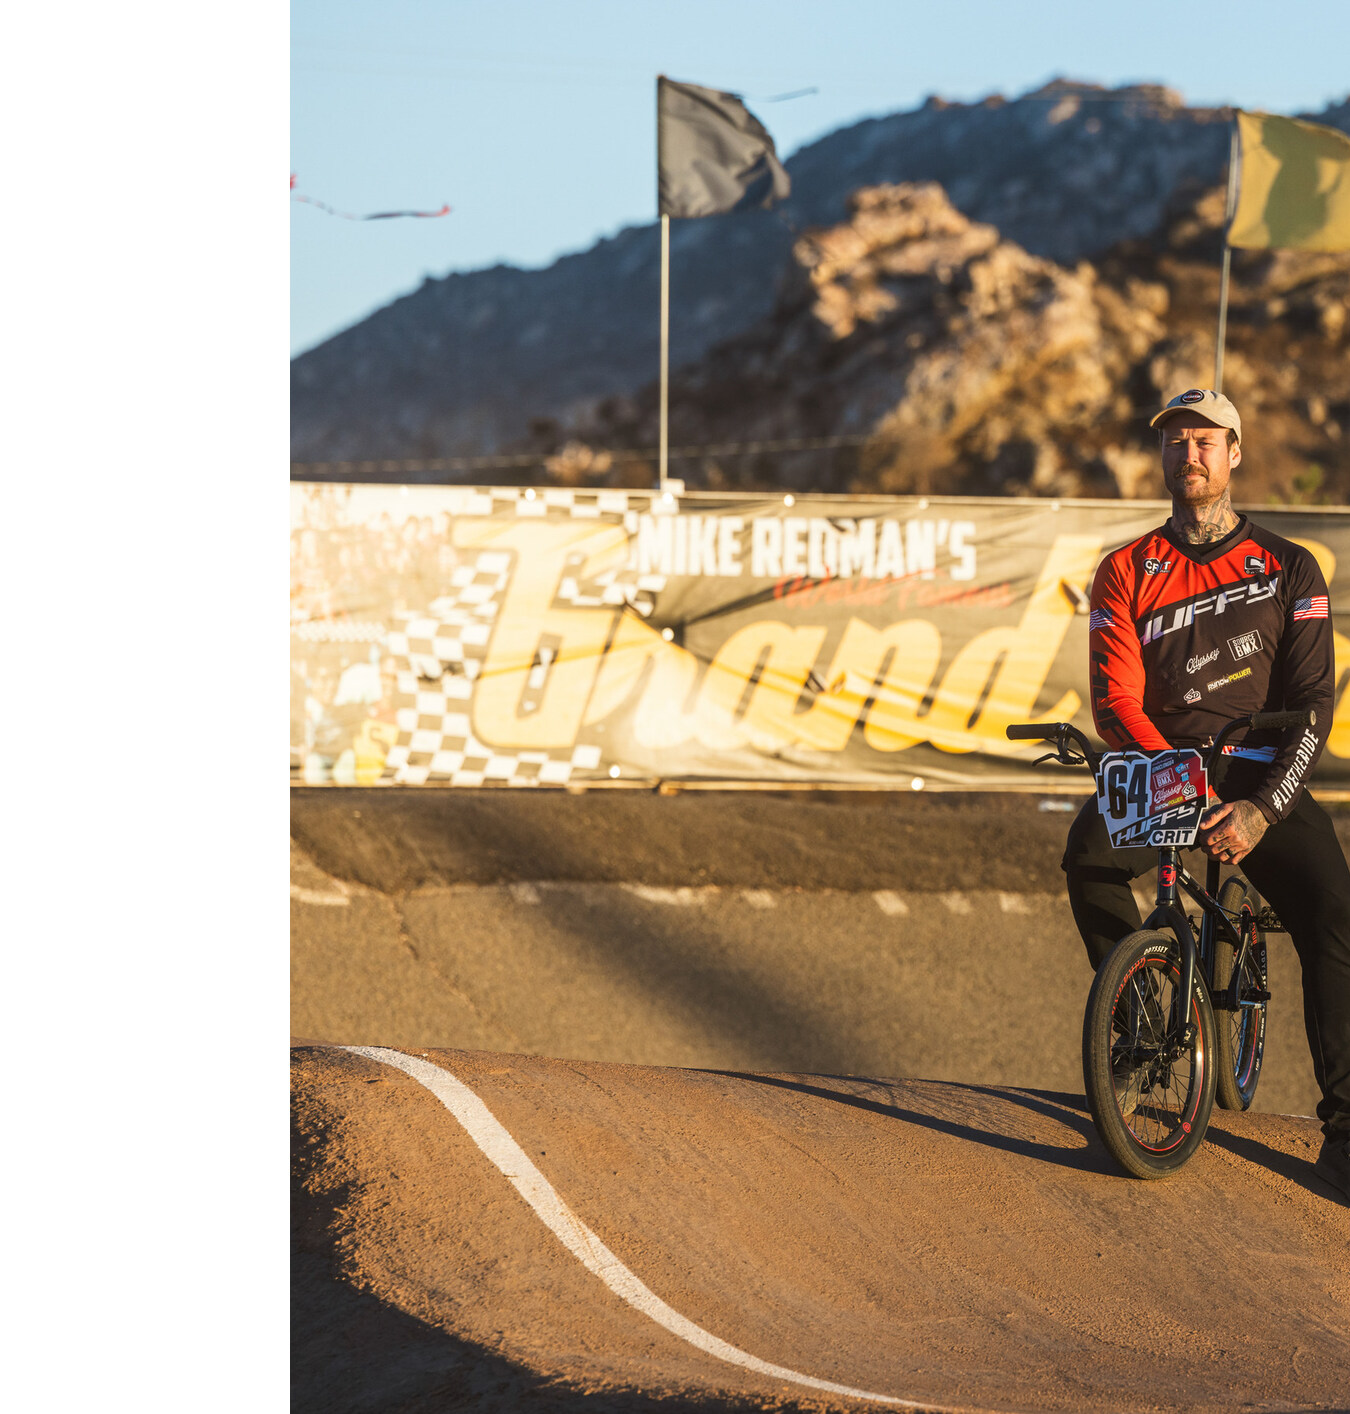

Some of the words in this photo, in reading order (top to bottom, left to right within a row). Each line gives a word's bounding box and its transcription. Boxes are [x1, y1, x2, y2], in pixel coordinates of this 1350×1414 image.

[639, 515, 744, 577] MIKE
[752, 517, 977, 581] REDMAN'S
[1232, 633, 1255, 647] SOURCE
[1235, 639, 1259, 658] BMX
[1186, 647, 1220, 675] Odyssey
[1271, 728, 1319, 812] #LIVETHERIDE
[1108, 763, 1149, 820] 64
[1116, 801, 1198, 846] HUFFY
[1151, 830, 1193, 845] CRIT
[1143, 945, 1169, 955] ODYSSEY
